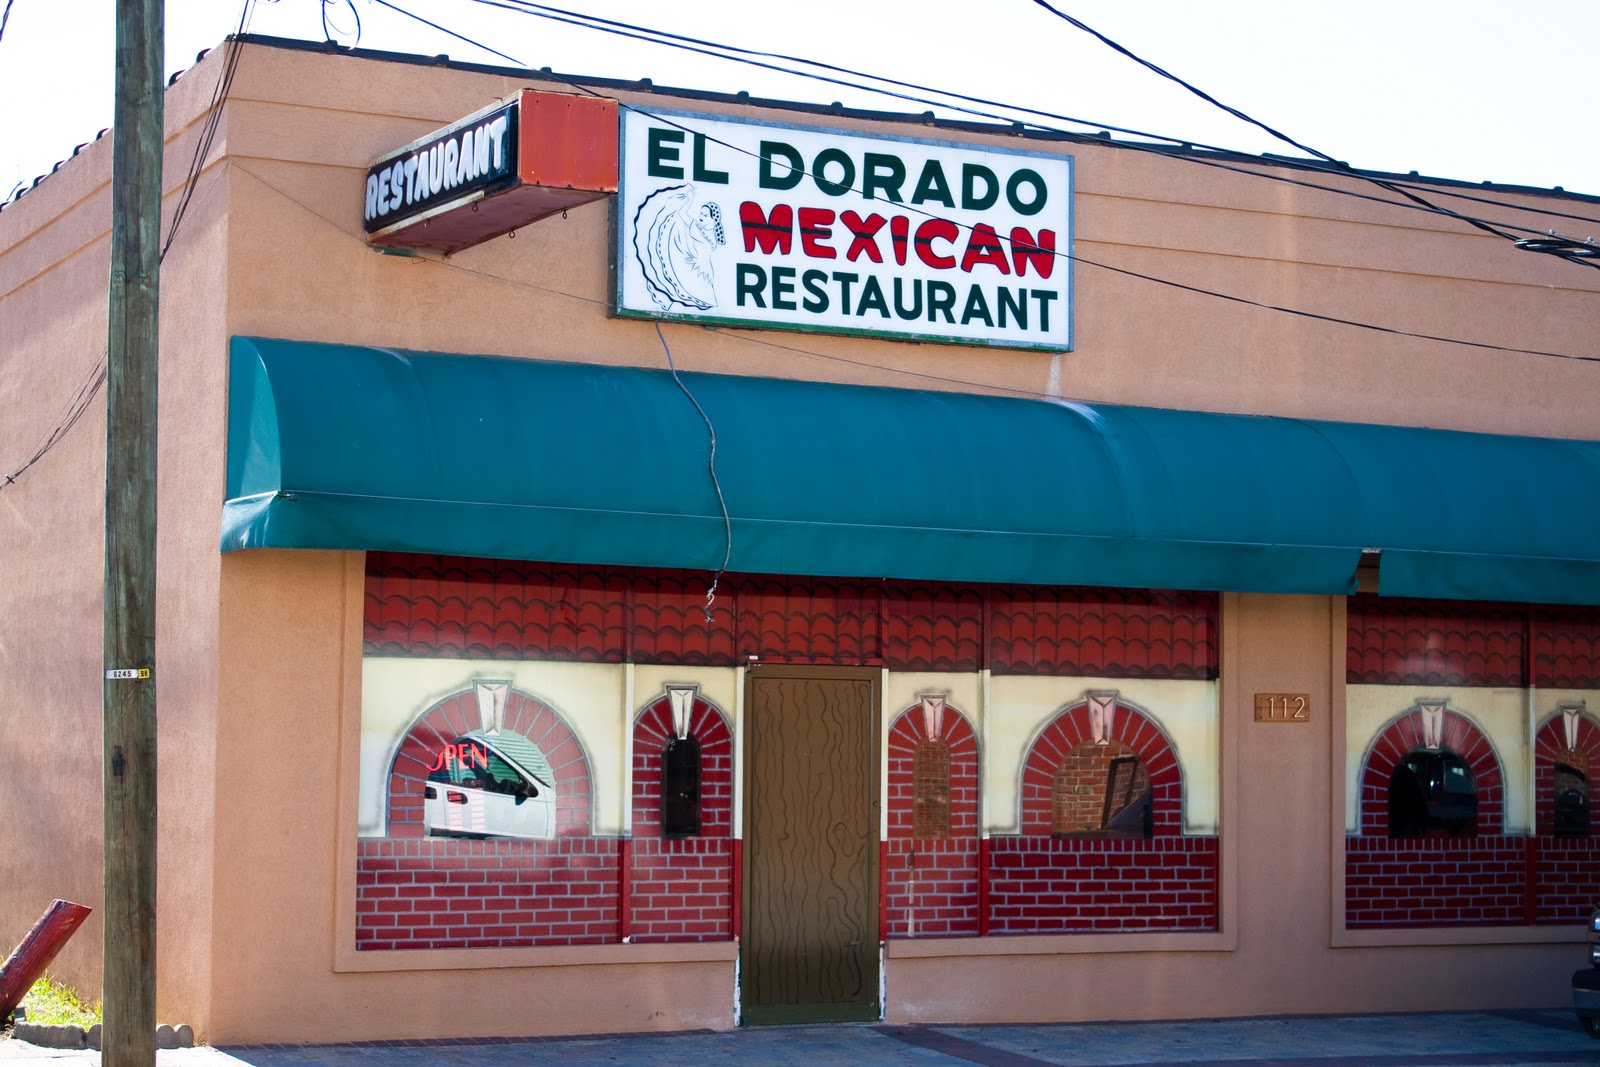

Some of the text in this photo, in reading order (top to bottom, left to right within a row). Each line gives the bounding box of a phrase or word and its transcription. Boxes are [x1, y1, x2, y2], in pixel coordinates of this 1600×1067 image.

[365, 116, 507, 220] RESTAURANT
[649, 127, 1048, 216] EL DORADO
[739, 201, 1056, 279] MEXICAN
[736, 264, 1059, 332] RESTAURANT
[113, 670, 132, 678] 6245
[1269, 696, 1305, 718] 112
